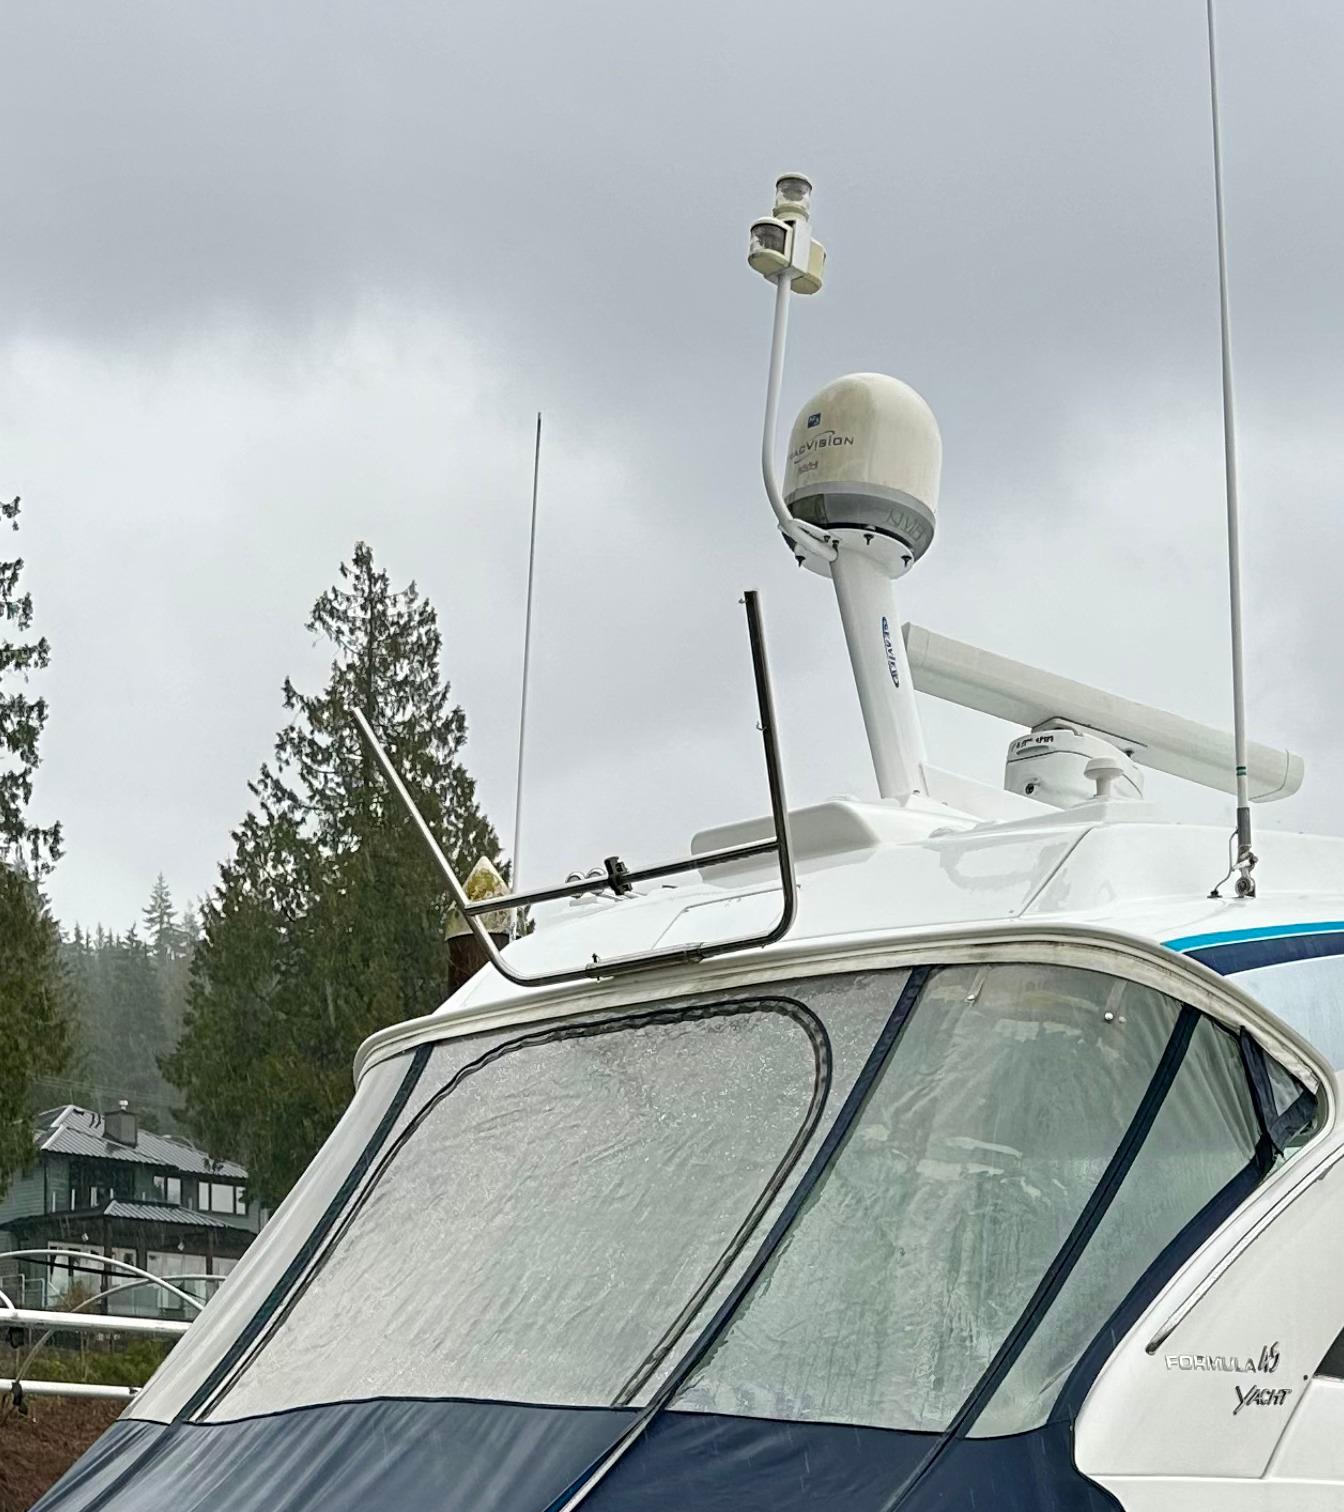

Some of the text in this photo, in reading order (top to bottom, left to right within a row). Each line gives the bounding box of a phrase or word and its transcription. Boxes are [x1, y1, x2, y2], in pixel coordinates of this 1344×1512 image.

[1165, 1341, 1280, 1373] FORMULA 45
[1233, 1385, 1292, 1415] YACHT
